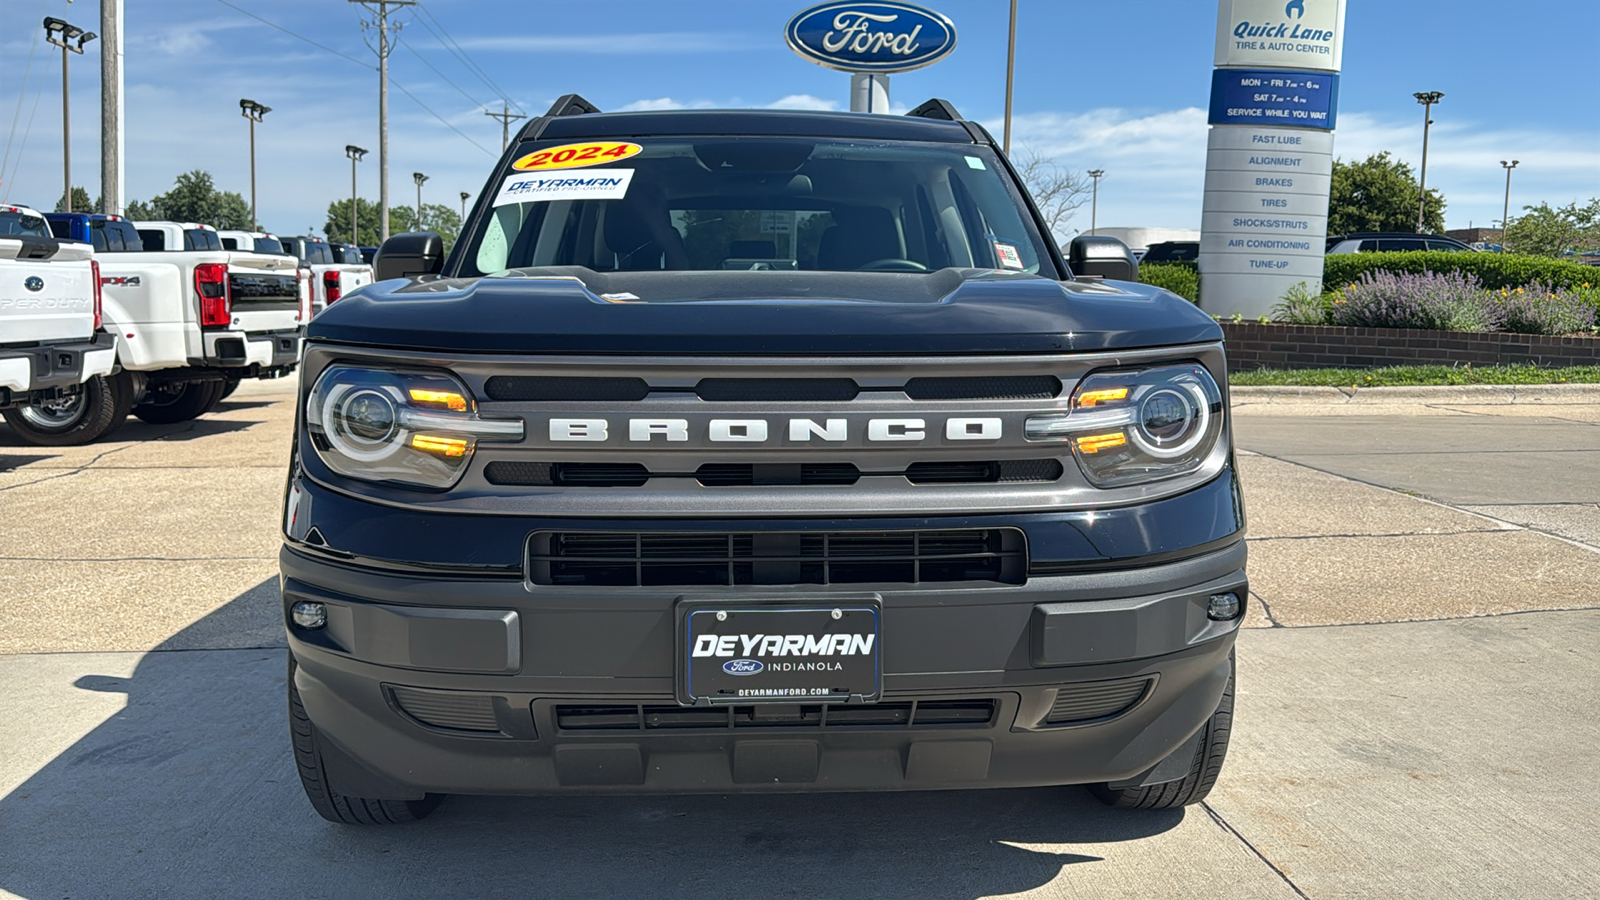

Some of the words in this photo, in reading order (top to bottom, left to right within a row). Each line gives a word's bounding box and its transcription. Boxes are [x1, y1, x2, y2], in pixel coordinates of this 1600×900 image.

[823, 11, 922, 55] Ford
[1234, 21, 1289, 38] Quick
[1289, 24, 1333, 41] Lane
[1235, 41, 1257, 50] TIRE
[1259, 42, 1266, 50] &
[1268, 43, 1294, 51] AUTO
[1296, 44, 1330, 54] CENTER
[1241, 78, 1261, 87] MON
[1270, 79, 1283, 87] FRI
[1253, 94, 1269, 102] SAT
[1227, 108, 1262, 116] SERVICE
[1265, 109, 1290, 117] WHILE
[1292, 110, 1308, 118] YOU
[1310, 111, 1327, 120] WAIT
[1252, 135, 1276, 143] FAST
[1277, 136, 1301, 145] LUBE
[524, 144, 629, 168] 2024
[1249, 157, 1302, 167] ALIGNMENT
[507, 178, 623, 192] DEYARMAN
[1255, 178, 1293, 187] BRAKES
[513, 187, 560, 195] CERTIFIED
[1261, 198, 1287, 208] TIRES
[1233, 218, 1308, 229] SHOCKS/STRUTS
[1228, 239, 1244, 247] AIR
[1246, 240, 1310, 250] CONDITIONING
[1249, 259, 1289, 269] TUNE-UP
[45, 298, 89, 309] DUTY
[549, 417, 1002, 442] BRONCO
[692, 633, 875, 657] DEYARMAN
[730, 662, 755, 672] Ford
[768, 662, 843, 672] INDIANOLA
[738, 688, 829, 697] DEYARMANFORD.COM
